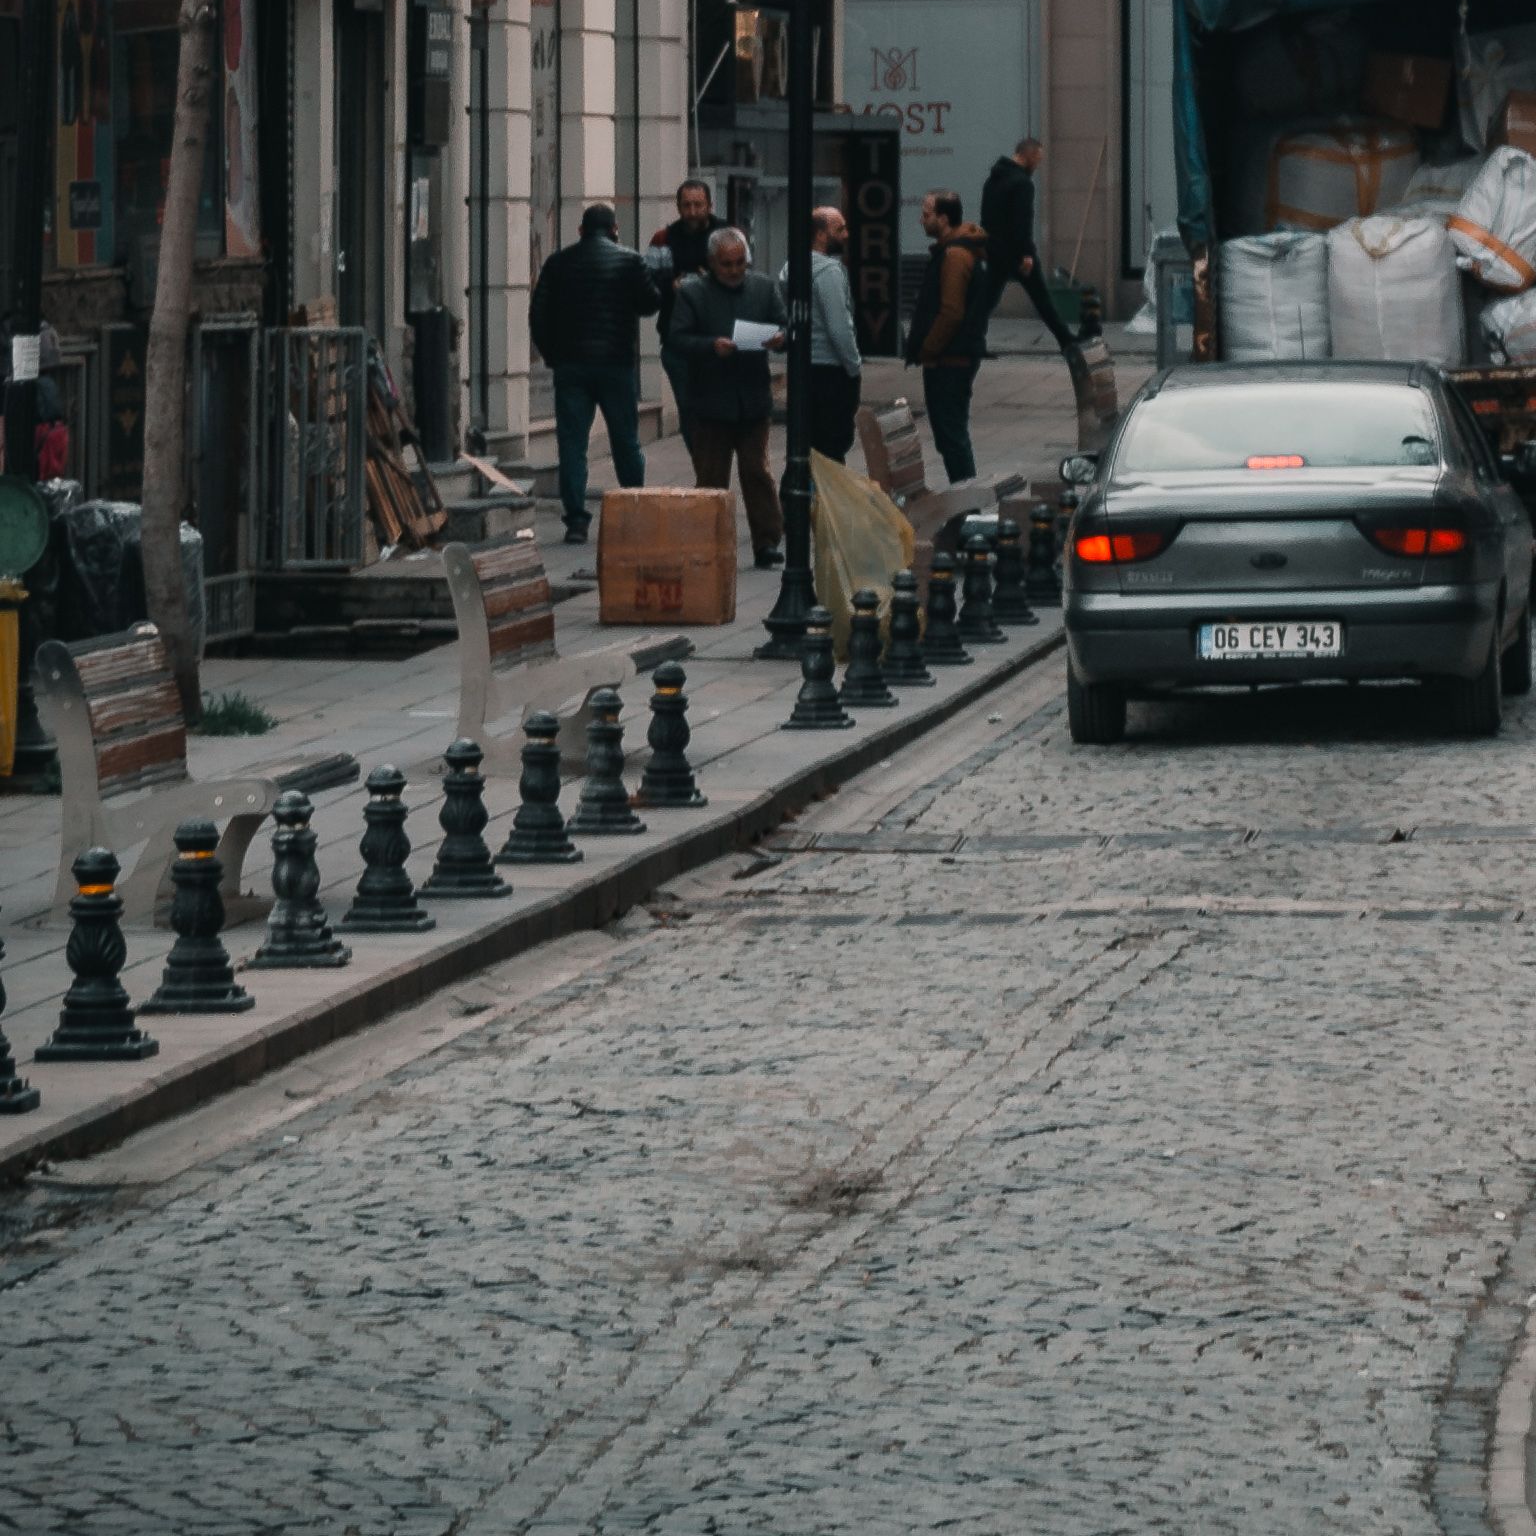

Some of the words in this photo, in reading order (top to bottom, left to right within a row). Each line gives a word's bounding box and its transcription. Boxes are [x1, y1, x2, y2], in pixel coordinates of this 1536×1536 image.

[1214, 627, 1240, 650] 06
[1249, 626, 1289, 649] CEY
[1296, 625, 1335, 649] 343
